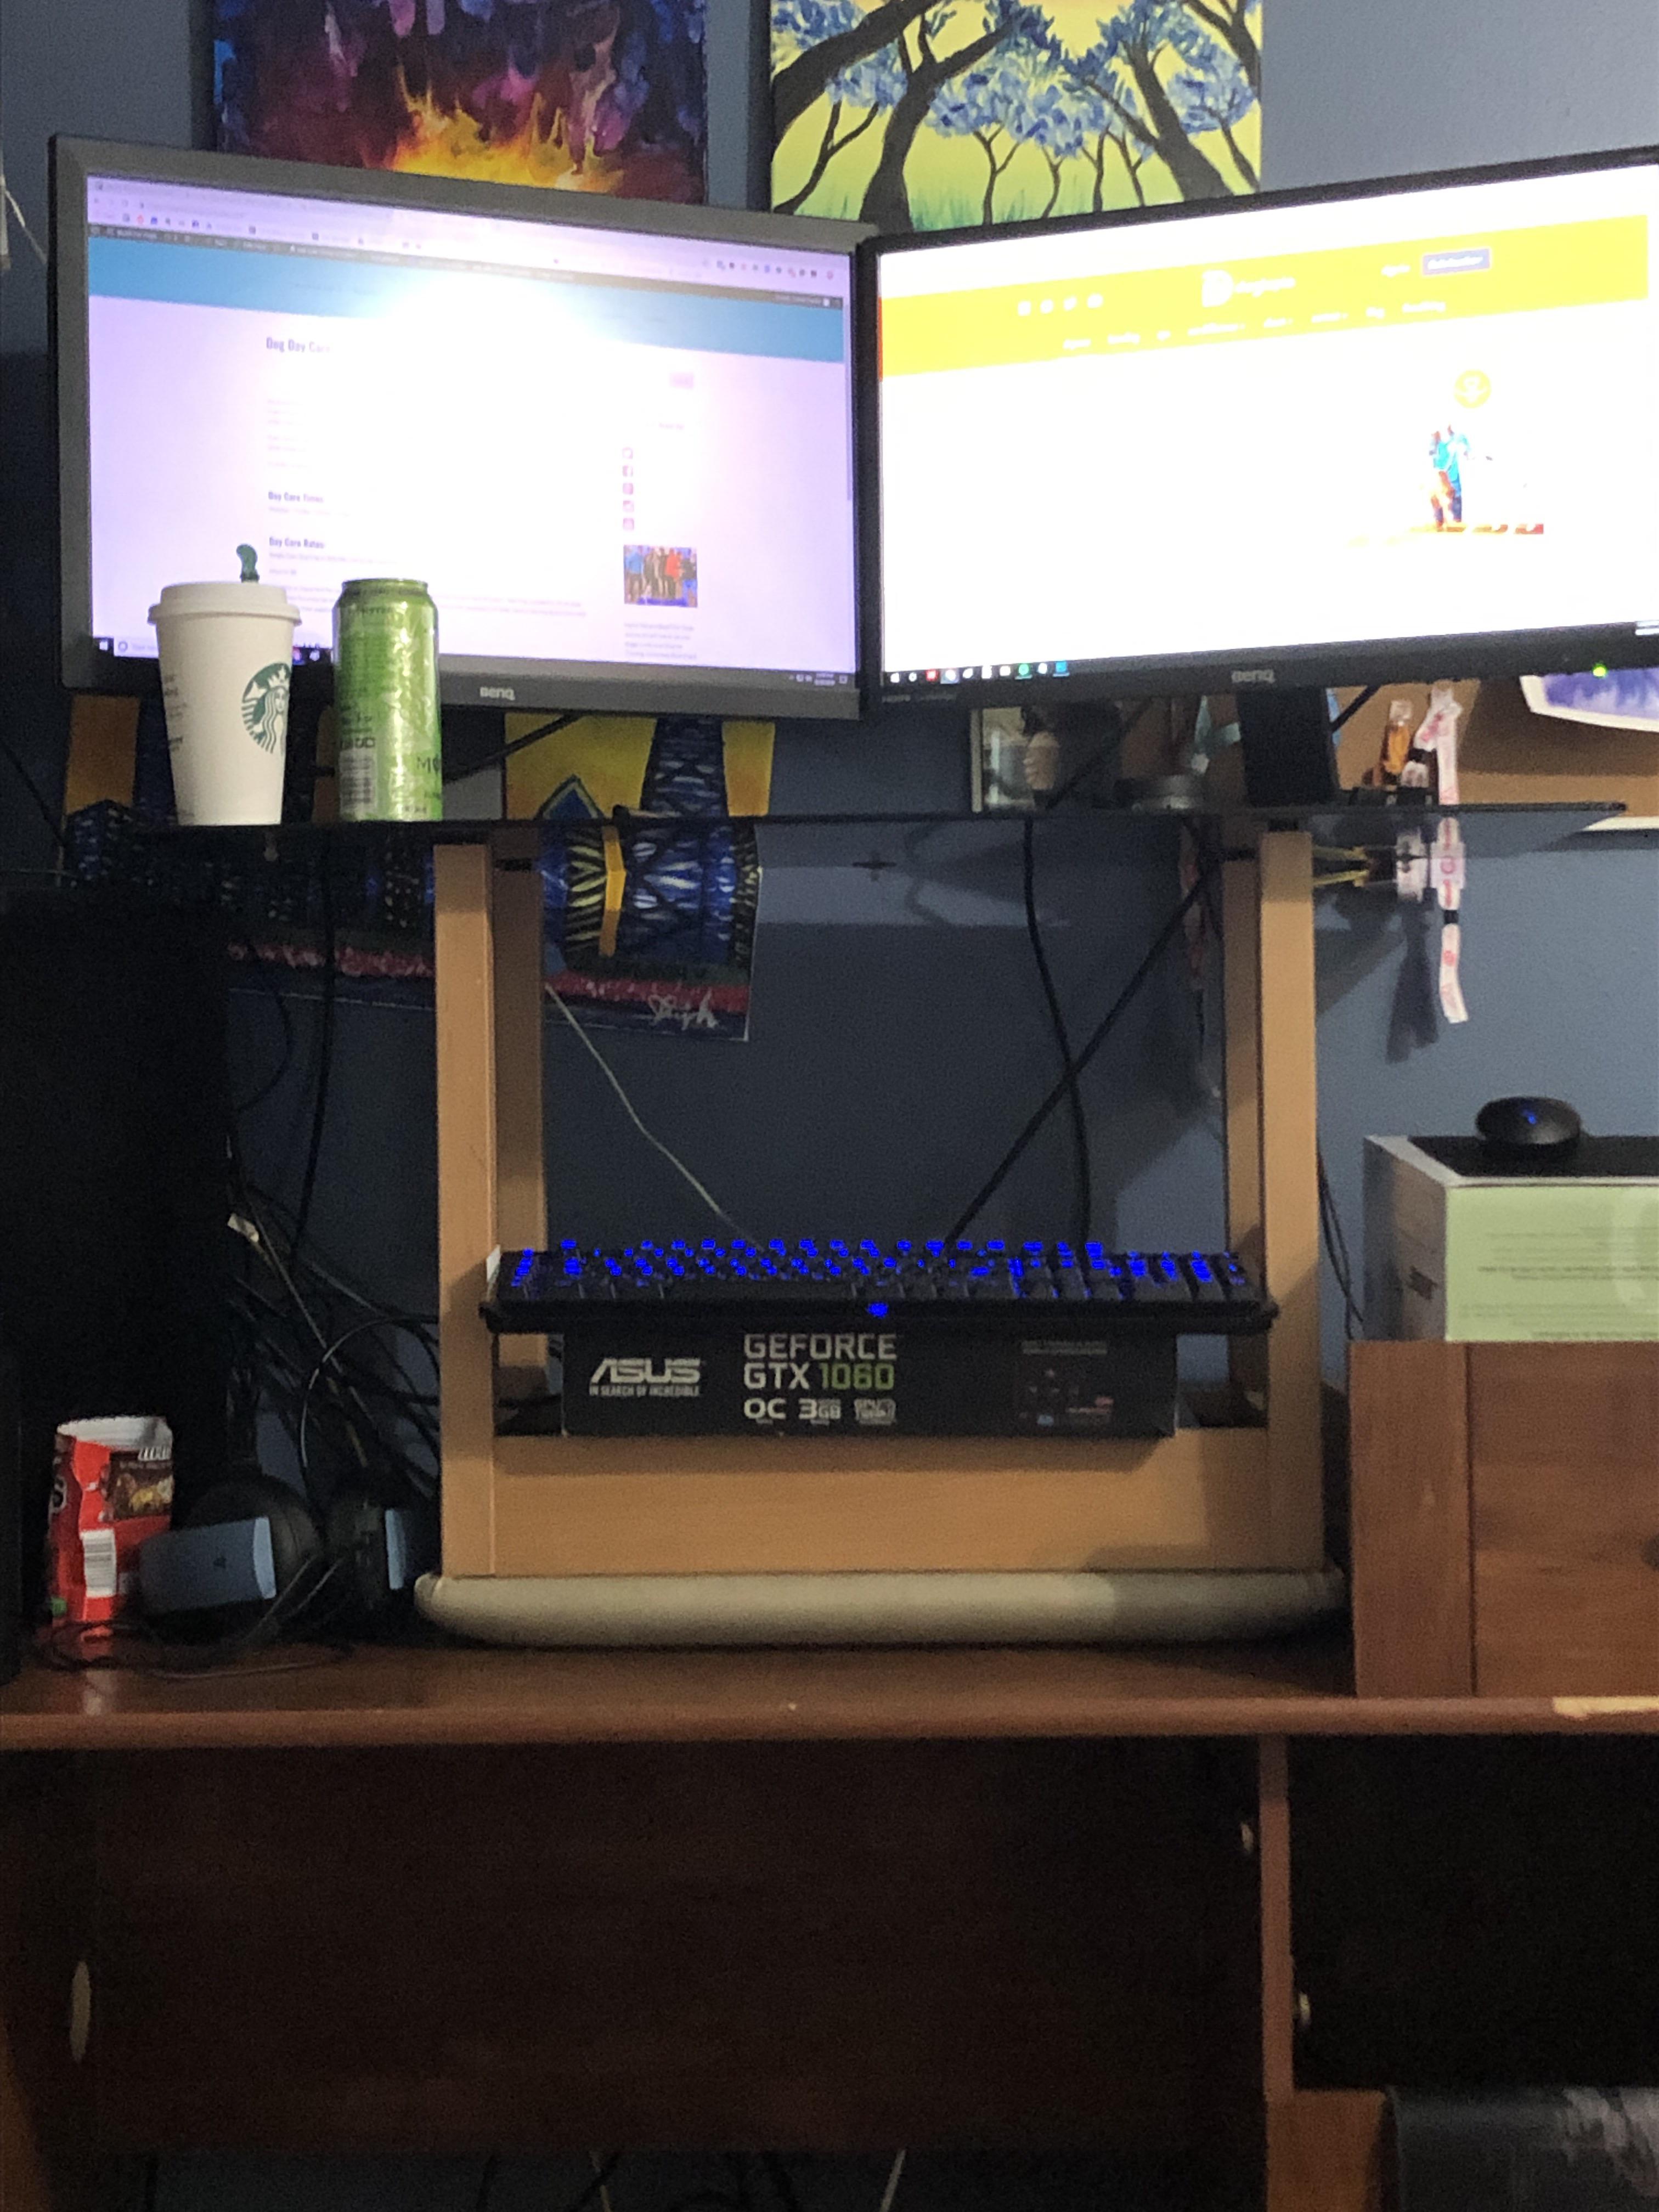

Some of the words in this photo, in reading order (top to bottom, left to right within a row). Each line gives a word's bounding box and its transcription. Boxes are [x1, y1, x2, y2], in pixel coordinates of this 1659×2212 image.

[266, 336, 284, 352] Dog
[288, 338, 306, 352] Day
[268, 491, 281, 502] Day
[284, 492, 300, 502] Care
[269, 535, 282, 548] Day
[285, 537, 301, 548] Care
[480, 686, 516, 701] BenQ
[744, 1334, 897, 1360] GEFORCE
[591, 1358, 701, 1384] ASUS
[743, 1362, 810, 1390] GTX
[819, 1362, 895, 1390] 1060
[600, 1385, 634, 1396] SEARCH
[649, 1385, 699, 1397] INCREDIBLE
[744, 1397, 786, 1420] OC
[798, 1397, 842, 1420] 3GB
